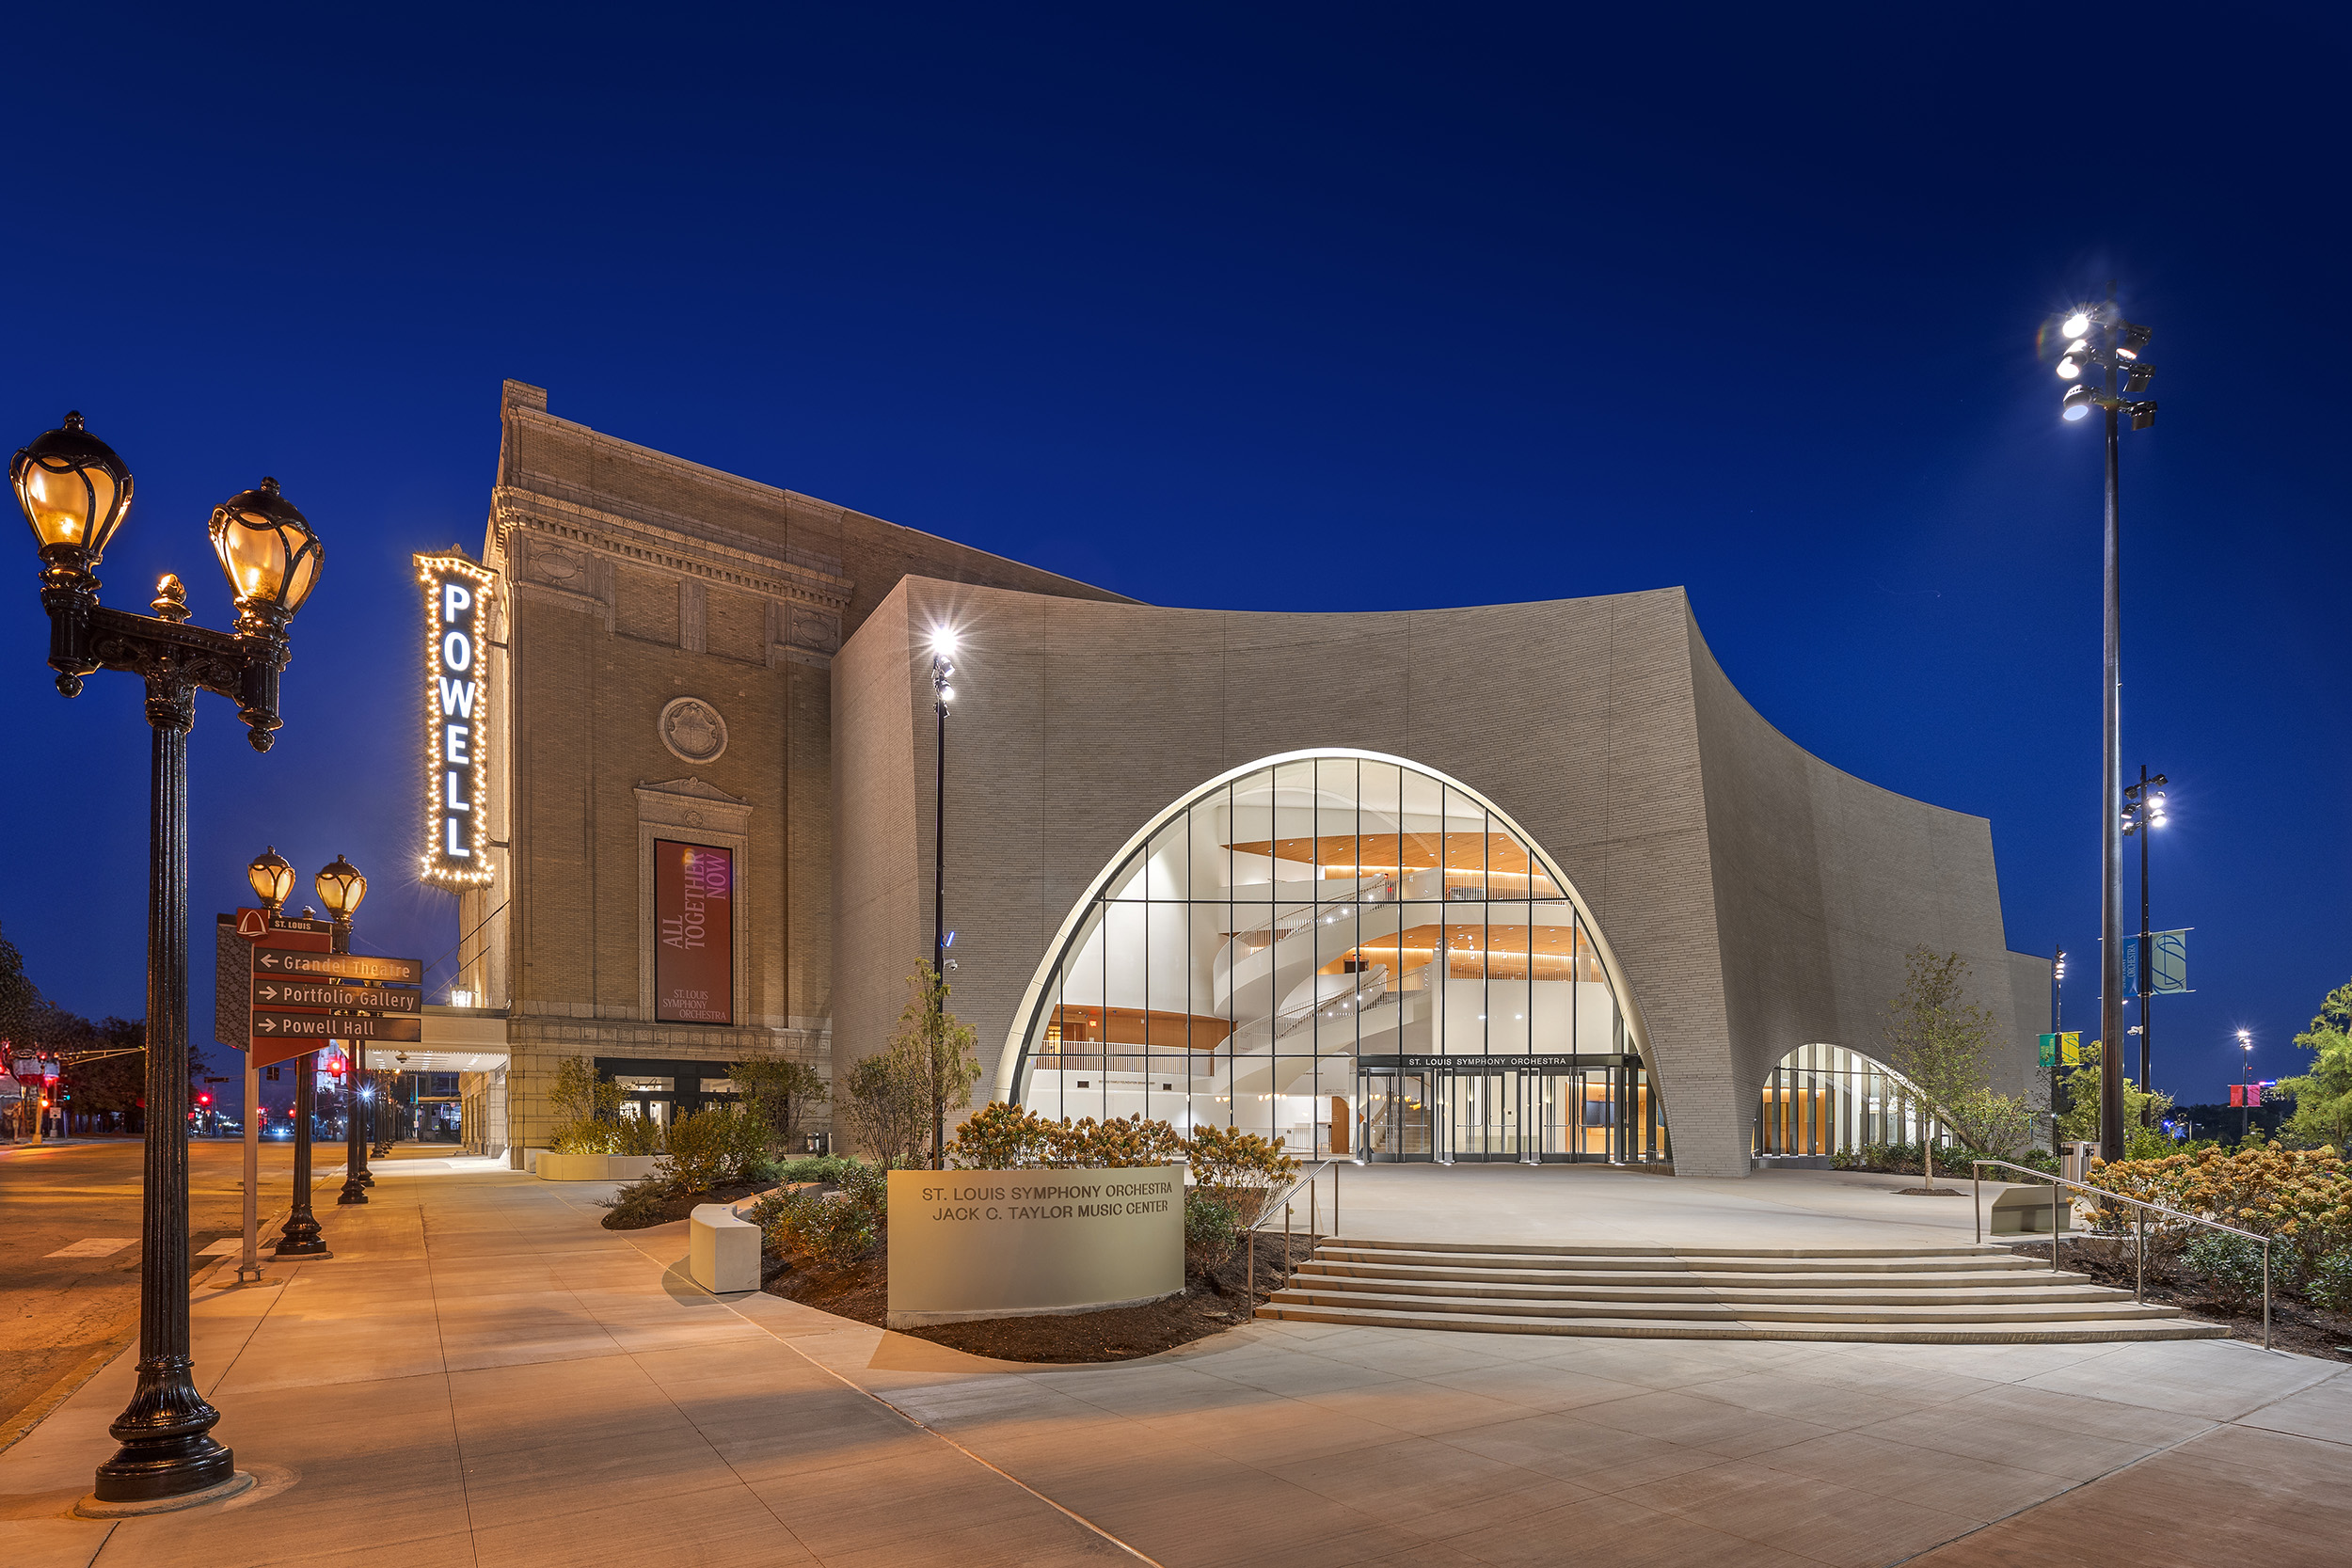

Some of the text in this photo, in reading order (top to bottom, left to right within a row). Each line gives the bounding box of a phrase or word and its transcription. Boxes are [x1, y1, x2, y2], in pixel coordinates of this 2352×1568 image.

[438, 583, 476, 858] POWELL
[706, 852, 726, 900] NOW
[684, 851, 706, 951] TOGETHER
[275, 920, 287, 929] ST.
[662, 914, 683, 950] ALL
[284, 956, 411, 978] Grandel Theatre
[2126, 943, 2136, 978] ORCHESTRA
[284, 988, 415, 1011] Portfolio Gallery
[662, 998, 707, 1009] SYMPHONY
[674, 989, 709, 1000] ST. LOUIS
[679, 1009, 726, 1021] ORCHESTRA
[282, 1019, 374, 1037] Powell Hall
[1510, 1057, 1566, 1066] ORCHESTRA
[922, 1181, 1173, 1201] ST. LOUIS SYMPHONY ORCHESTRA
[932, 1200, 1168, 1221] JACK C. TAYLOR MUSIC CENTER
